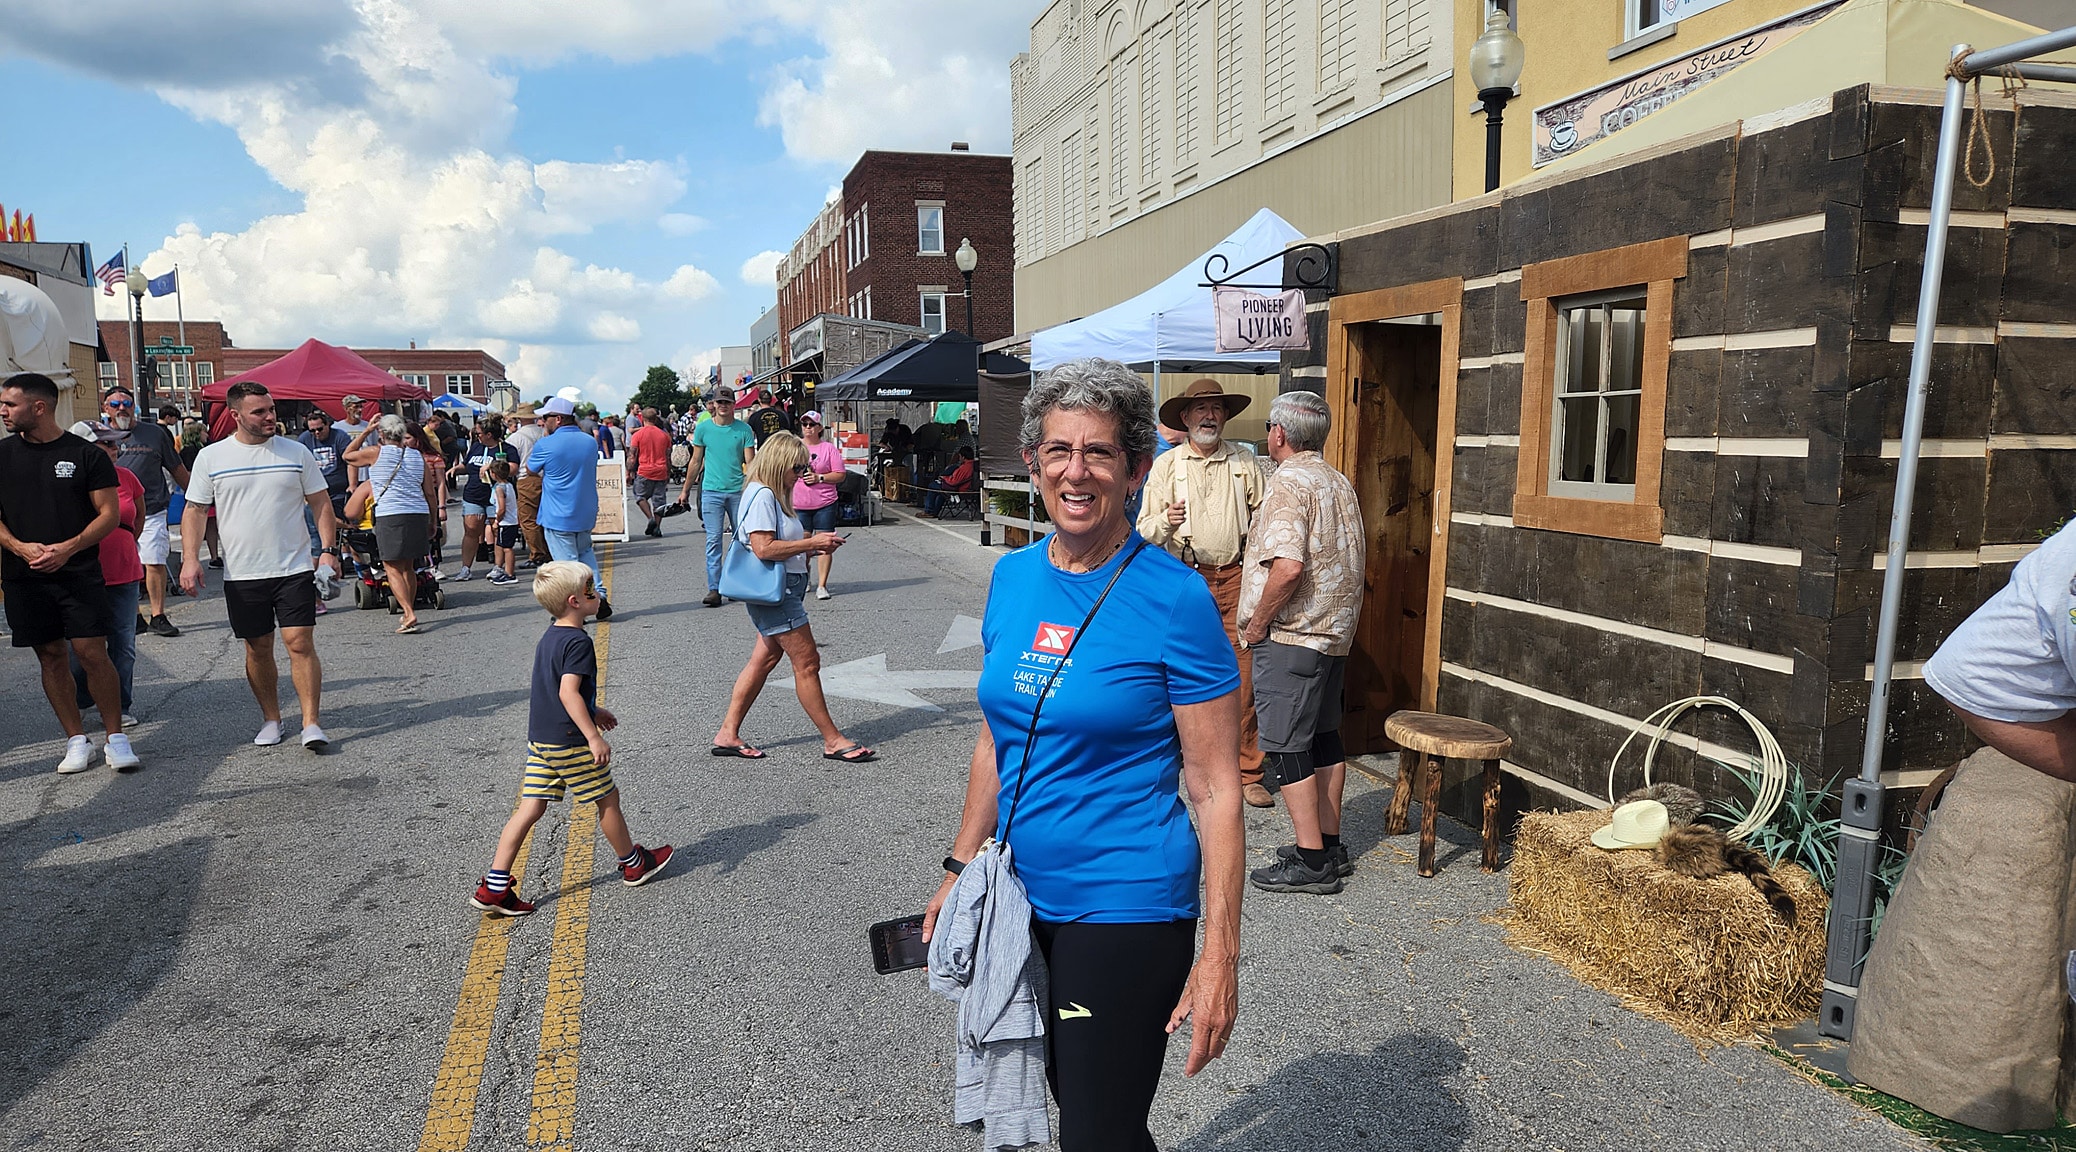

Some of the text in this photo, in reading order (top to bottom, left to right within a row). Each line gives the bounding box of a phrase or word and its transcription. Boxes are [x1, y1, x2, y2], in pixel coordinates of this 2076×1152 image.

[1616, 70, 1681, 106] Main
[1686, 36, 1769, 75] Street
[1242, 299, 1284, 313] PIONEER
[1238, 317, 1292, 344] LIVING
[876, 388, 913, 396] Academy
[1013, 670, 1036, 682] LAKE
[1014, 682, 1037, 696] TRAIL
